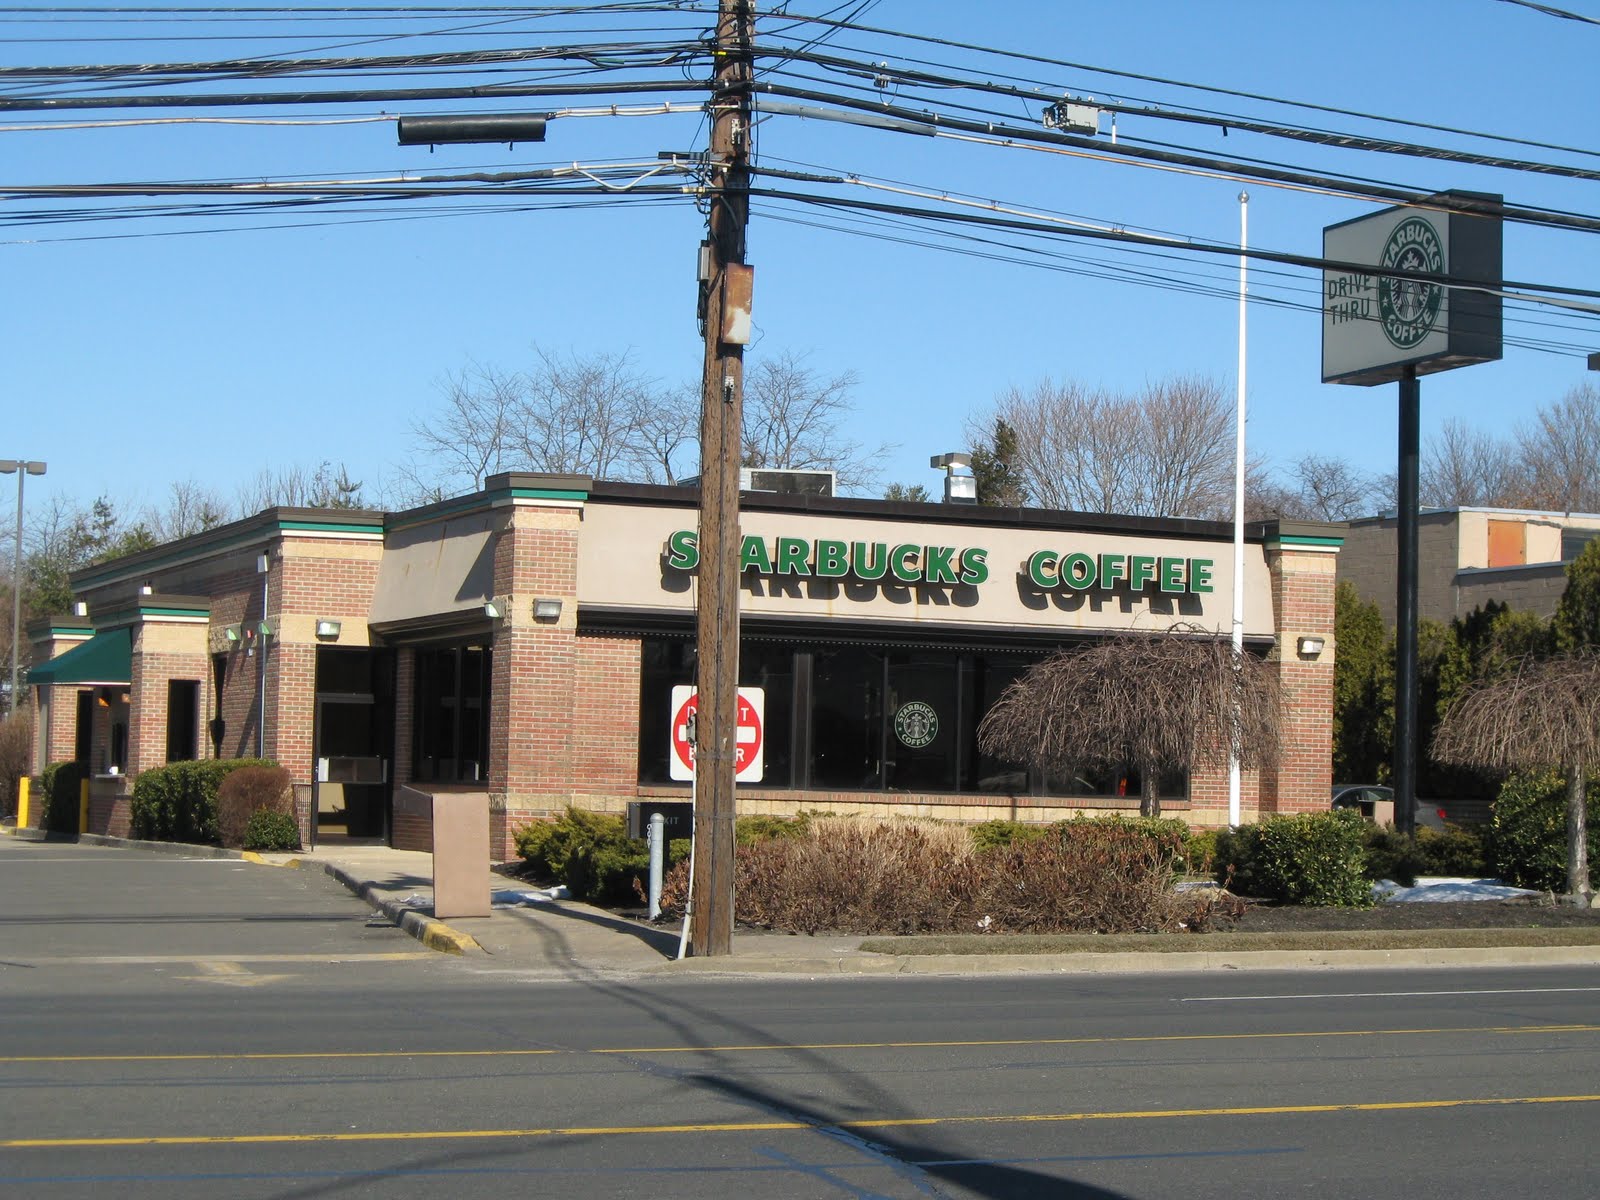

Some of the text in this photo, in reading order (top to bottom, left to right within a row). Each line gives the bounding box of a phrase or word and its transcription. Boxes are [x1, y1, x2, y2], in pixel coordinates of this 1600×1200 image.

[1328, 273, 1371, 300] DRIVE
[1330, 297, 1369, 325] THRU
[1387, 308, 1433, 341] COFFEE
[668, 529, 1215, 594] SARBUCKS COFFEE
[897, 703, 936, 723] STARBUCKS
[901, 733, 931, 746] COFFEE
[662, 816, 680, 825] XIT
